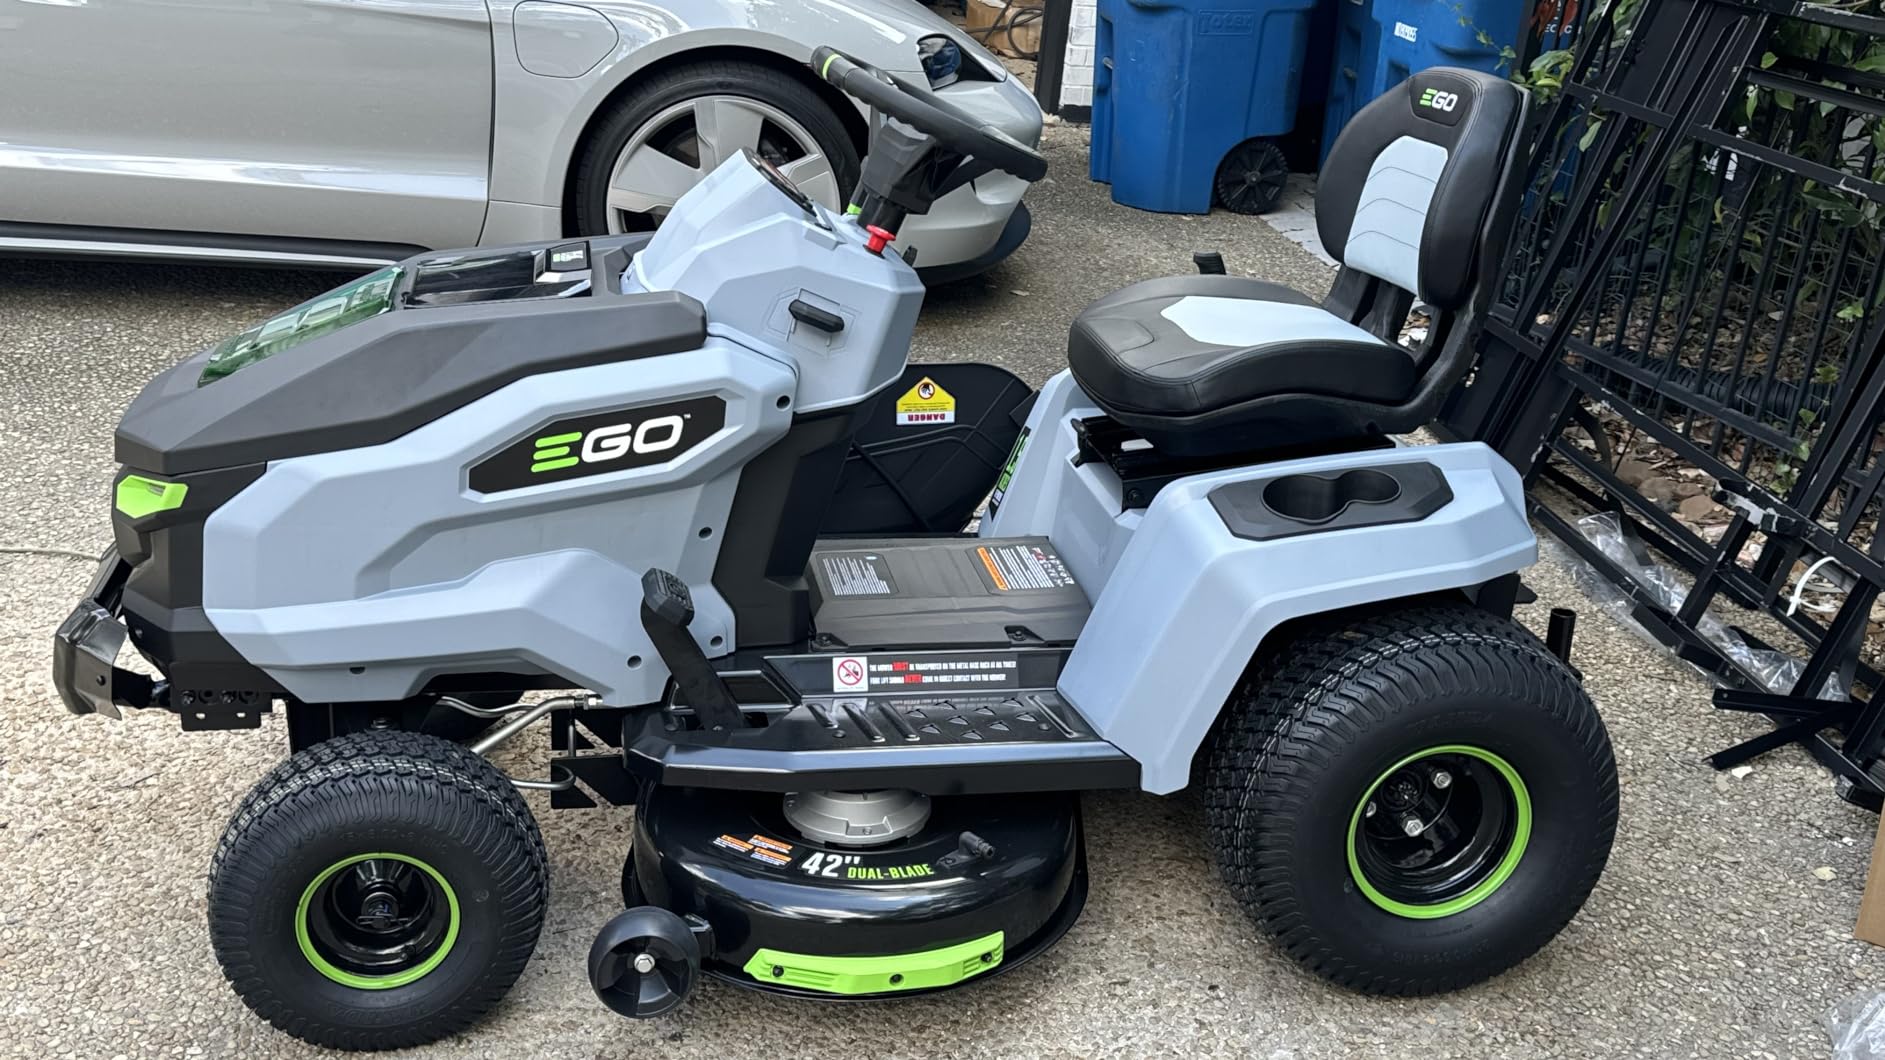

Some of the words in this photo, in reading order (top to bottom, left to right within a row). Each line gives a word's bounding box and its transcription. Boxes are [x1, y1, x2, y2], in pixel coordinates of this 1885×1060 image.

[1419, 88, 1458, 112] EGO
[907, 413, 945, 422] DANGER
[531, 415, 684, 473] EGO
[847, 863, 935, 880] DUAL-BLADE
